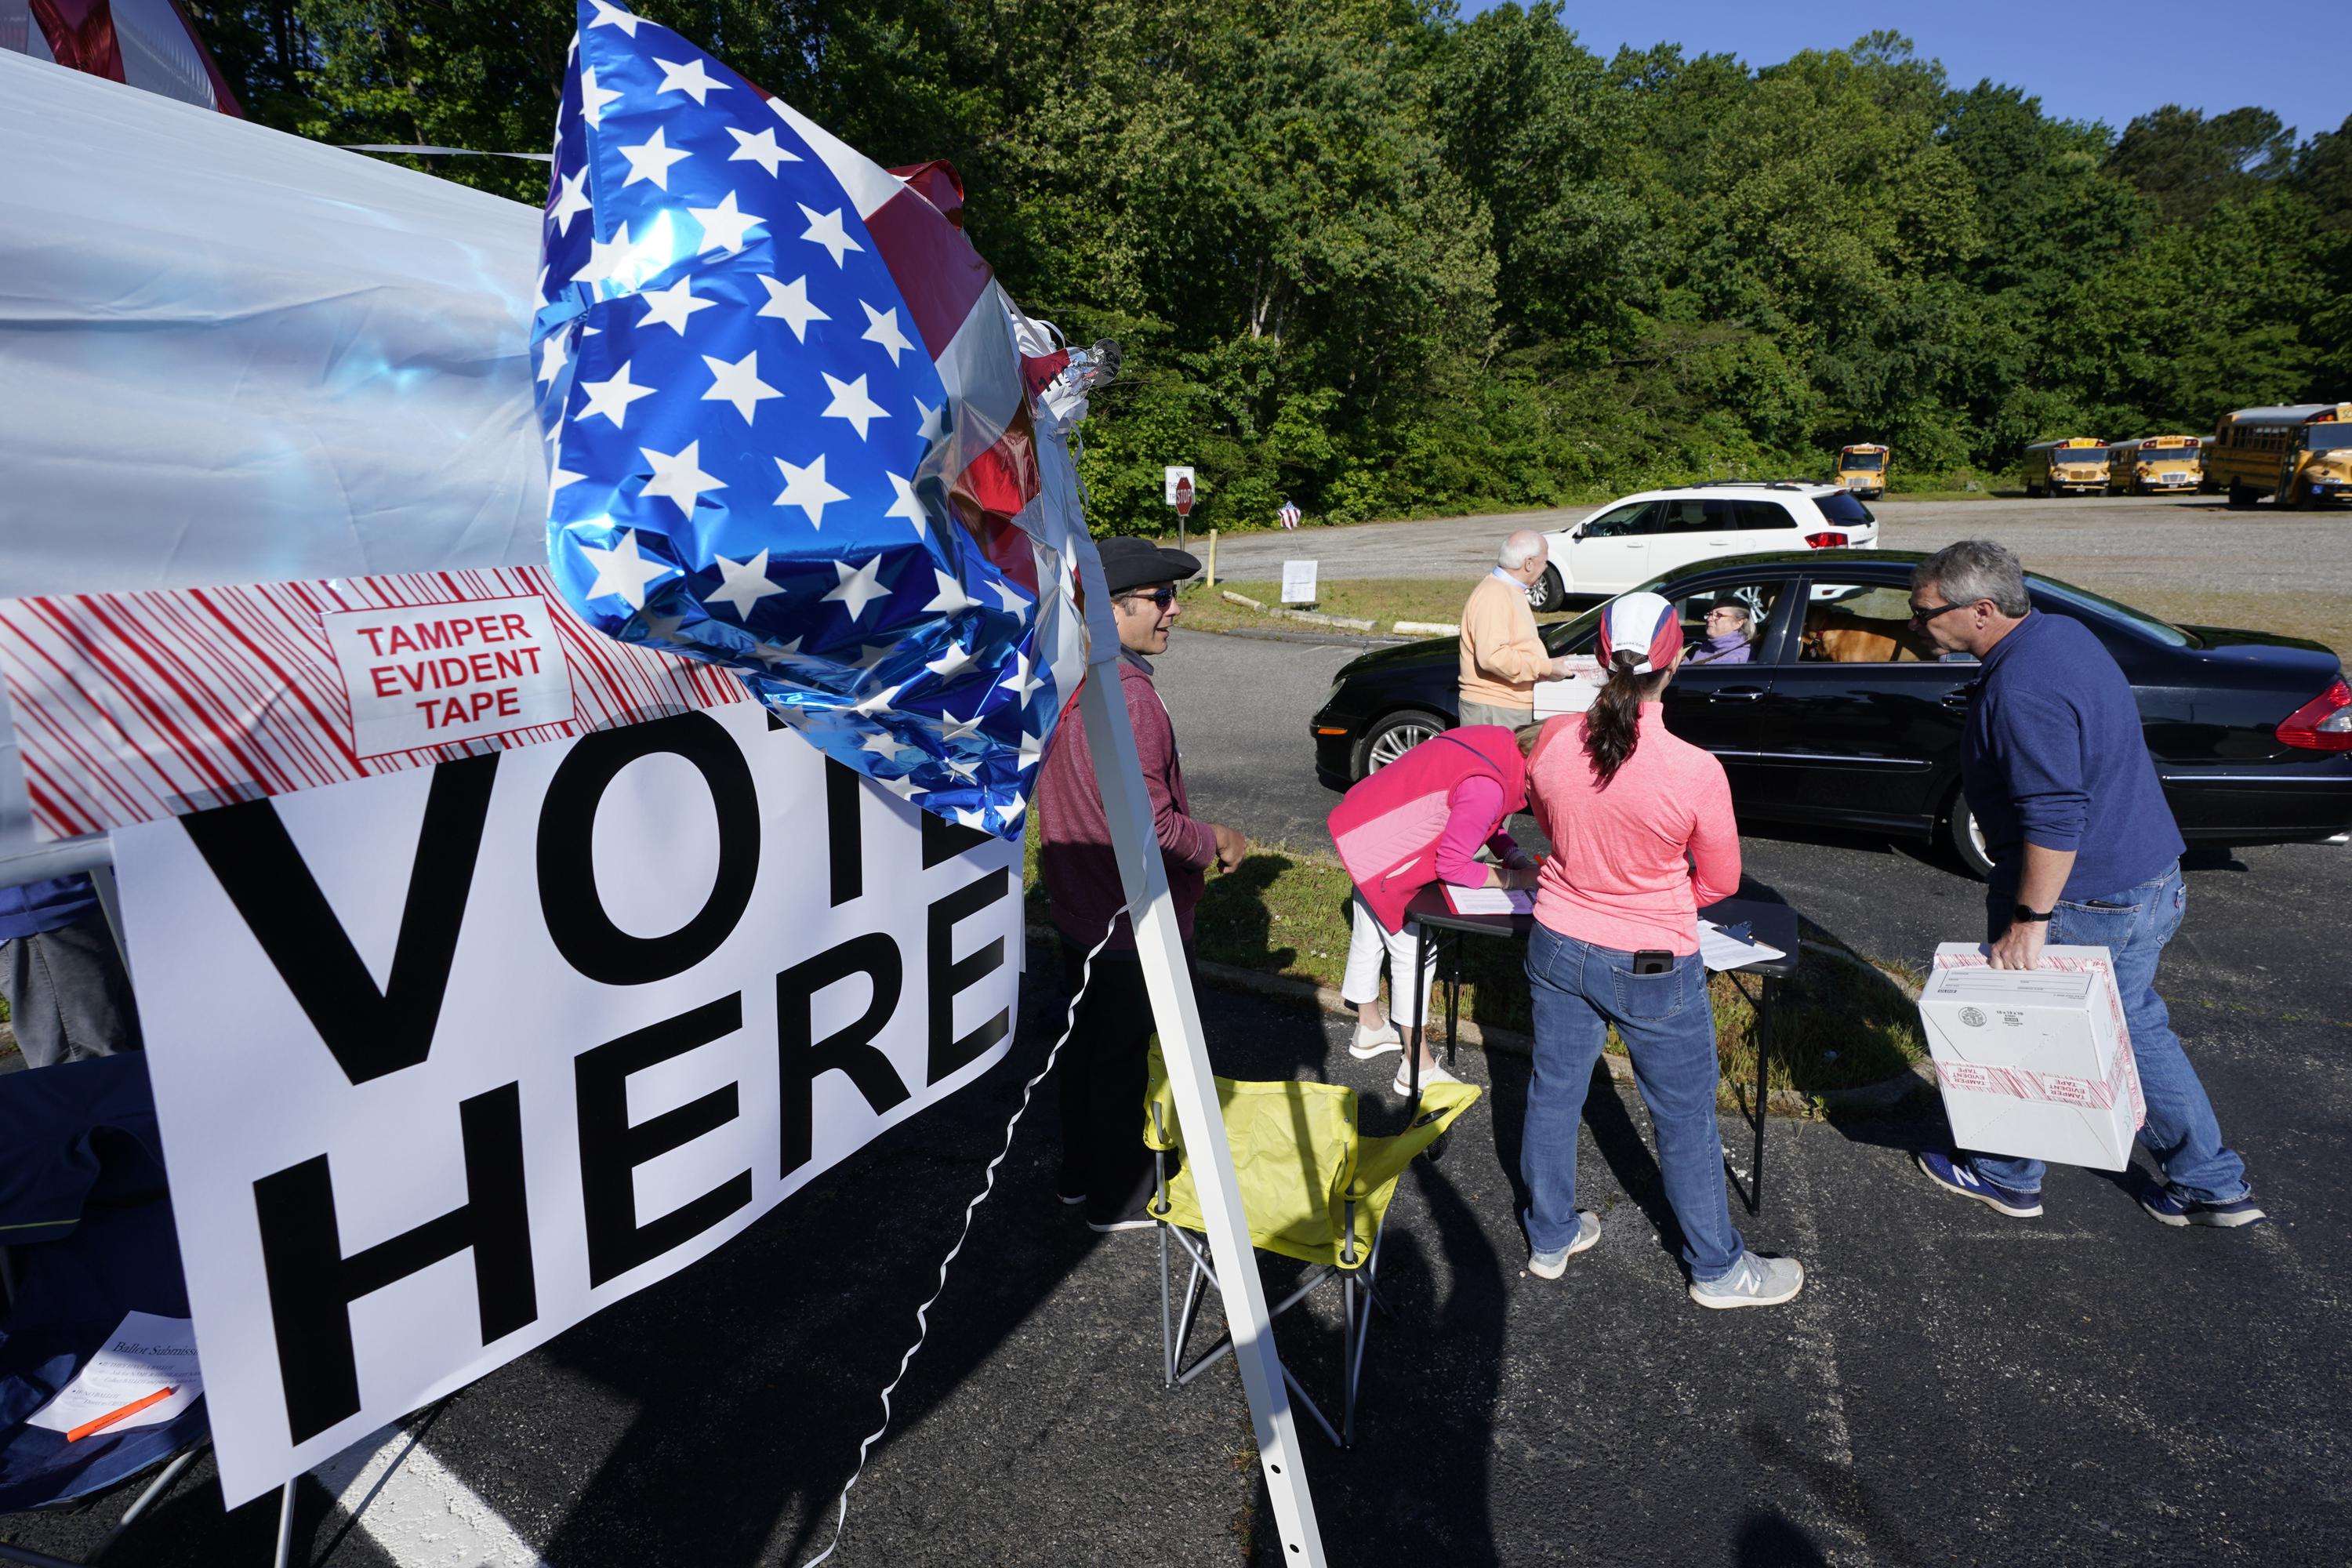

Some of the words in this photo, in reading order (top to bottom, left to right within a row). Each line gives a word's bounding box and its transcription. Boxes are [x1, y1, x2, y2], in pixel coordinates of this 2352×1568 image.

[1177, 488, 1192, 504] STOP
[357, 614, 532, 656] TAMPER
[369, 647, 541, 698] EVIDENT
[416, 688, 521, 729] TAPE
[2050, 1084, 2085, 1094] EVIDENT
[2051, 1090, 2085, 1099] TAMPER
[252, 864, 1010, 1447] HERE
[113, 1341, 149, 1355] Ballot
